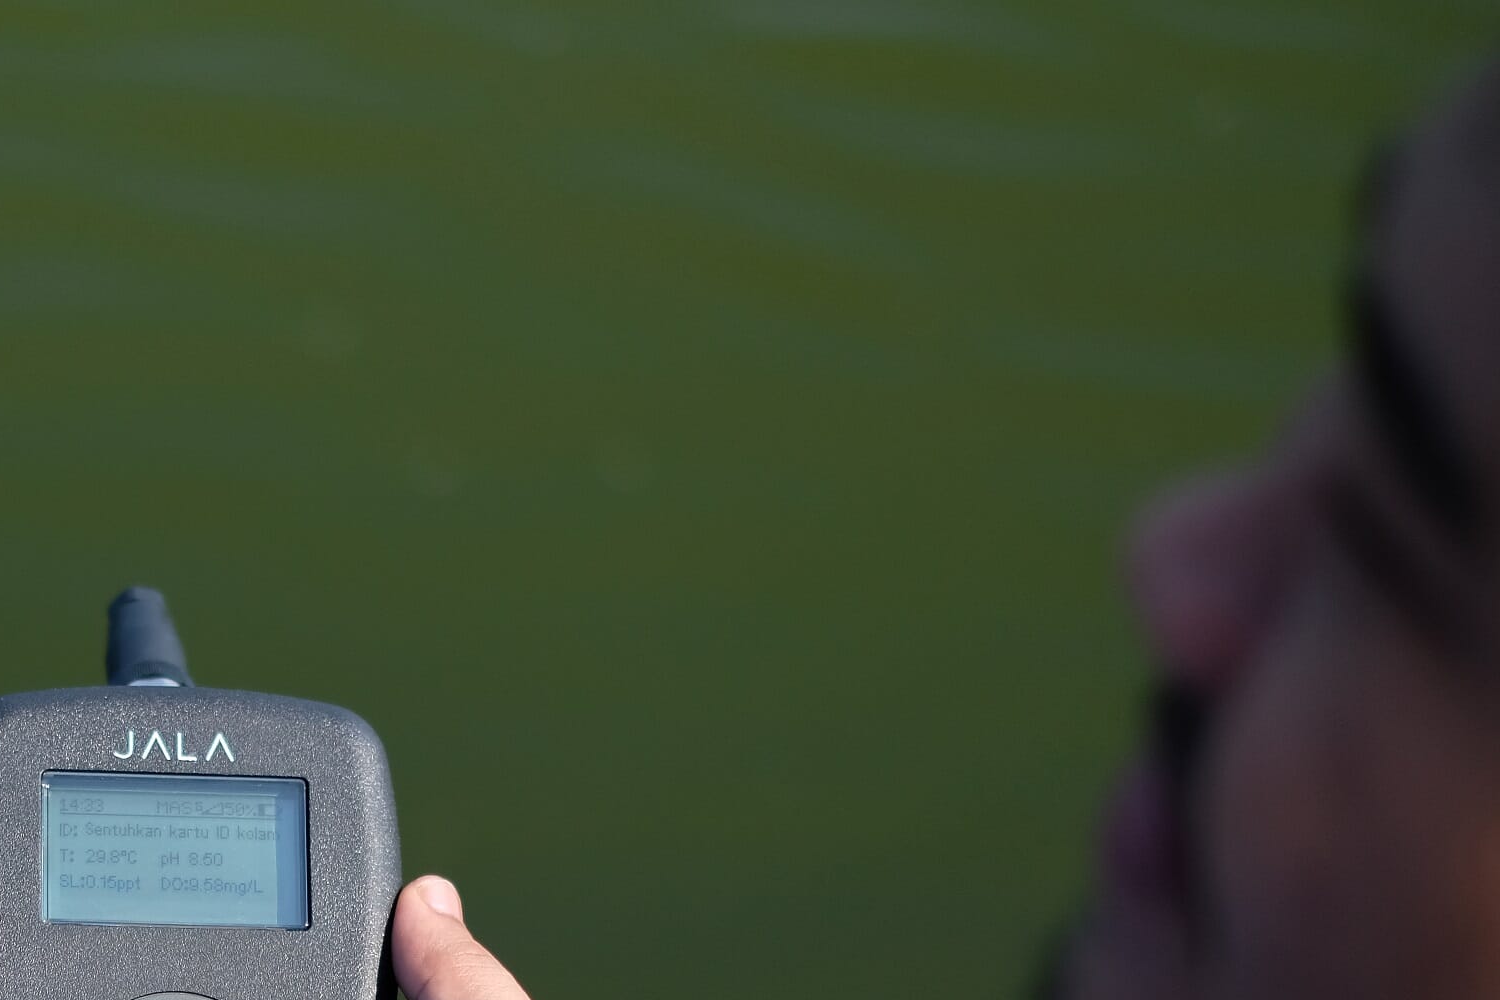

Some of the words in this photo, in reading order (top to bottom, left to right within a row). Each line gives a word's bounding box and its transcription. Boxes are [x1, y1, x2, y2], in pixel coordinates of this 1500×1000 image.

[113, 730, 235, 762] JALA
[59, 823, 78, 837] ID:
[85, 822, 162, 838] Sentuhkan
[169, 824, 209, 840] kartu
[216, 826, 230, 840] ID
[60, 849, 74, 862] T:
[161, 853, 180, 868] pH
